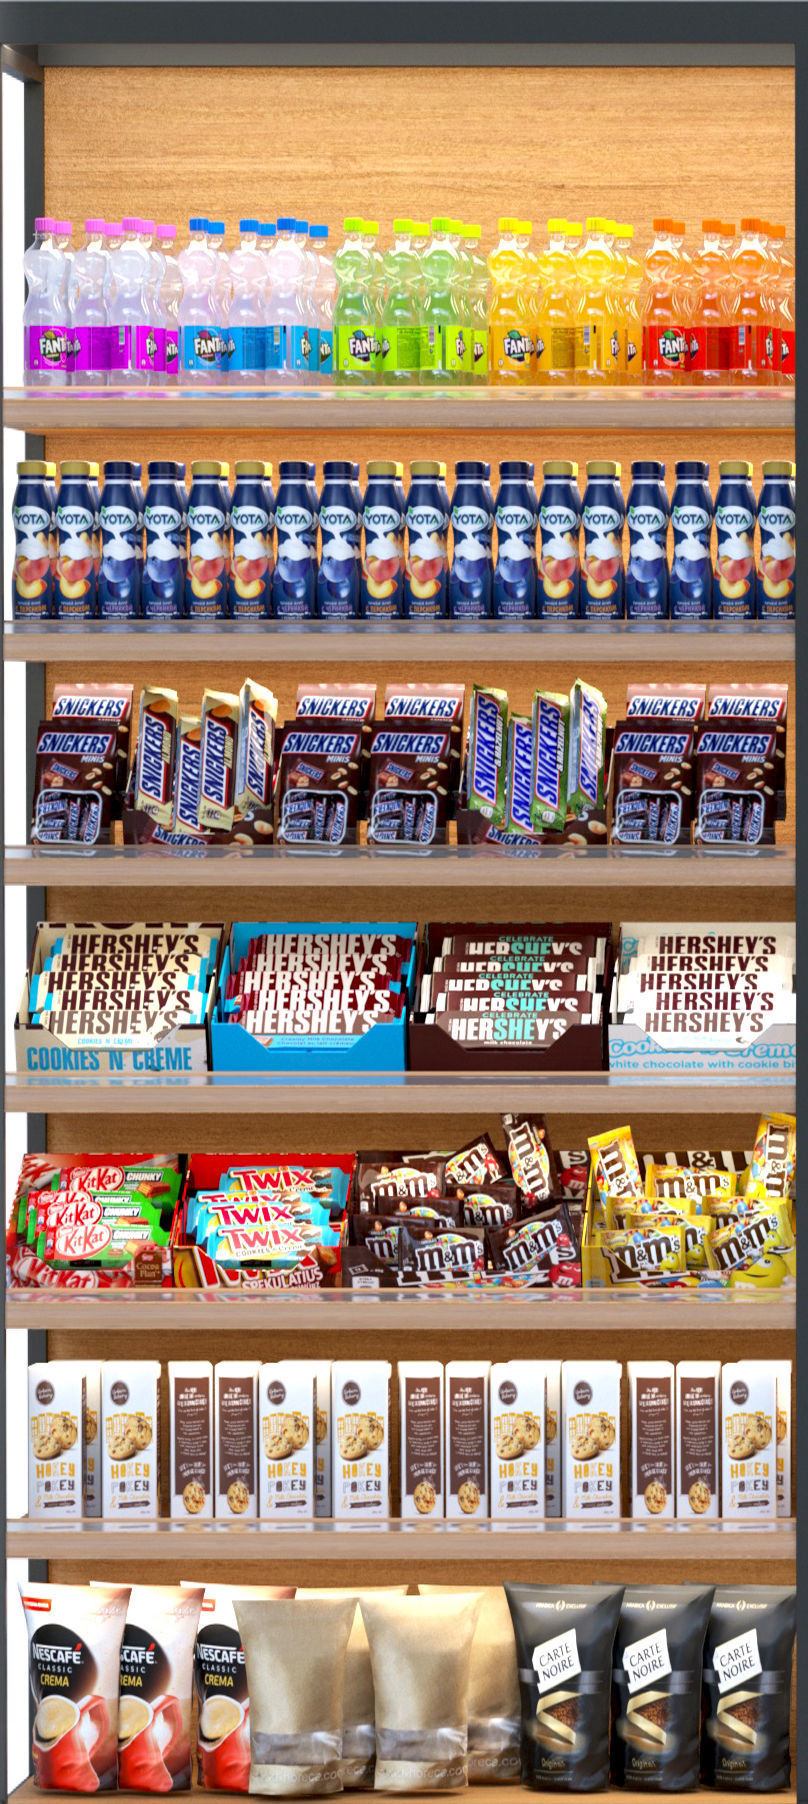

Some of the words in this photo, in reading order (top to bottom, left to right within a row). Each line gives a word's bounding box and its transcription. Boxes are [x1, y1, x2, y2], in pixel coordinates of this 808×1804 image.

[40, 336, 68, 355] FANT
[194, 336, 221, 355] FANT
[349, 336, 375, 355] FANT
[504, 336, 530, 355] FANT
[659, 336, 685, 355] FANT
[15, 514, 45, 525] YOTA
[58, 514, 88, 525] YOTA
[102, 514, 132, 525] YOTA
[146, 514, 176, 525] YOTA
[190, 514, 220, 525] YOTA
[234, 514, 263, 525] YOTA
[278, 514, 307, 525] YOTA
[321, 514, 351, 525] YOTA
[365, 514, 395, 525] YOTA
[409, 514, 439, 525] YOTA
[454, 514, 483, 525] YOTA
[498, 514, 528, 525] YOTA
[542, 514, 572, 525] YOTA
[586, 514, 615, 525] YOTA
[630, 514, 660, 525] YOTA
[674, 514, 704, 525] YOTA
[718, 514, 748, 525] YOTA
[761, 514, 791, 525] YOTA
[54, 698, 124, 717] SNICKERS
[299, 698, 368, 717] SNICKERS
[387, 698, 456, 717] SNICKERS
[630, 698, 699, 717] SNICKERS
[711, 698, 780, 717] SNICKERS
[39, 734, 110, 754] SNICKERS
[284, 734, 355, 754] SNICKERS
[373, 734, 444, 754] SNICKERS
[473, 695, 501, 801] SNICKERS
[537, 699, 562, 806] SNICKERS
[617, 734, 688, 754] SNICKERS
[699, 734, 770, 754] SNICKERS
[81, 755, 106, 763] MINIS
[142, 715, 165, 799] SNICKERS
[204, 720, 228, 802] SNICKERS
[327, 755, 352, 763] MINIS
[416, 755, 441, 763] MINIS
[659, 755, 684, 763] MINIS
[741, 755, 766, 763] MINIS
[71, 935, 199, 954] HERSHEY'S
[266, 935, 397, 955] HERSHEY'S
[659, 936, 776, 954] HERSHEY'S
[256, 954, 388, 974] HERSHEY'S
[244, 971, 376, 993] HERSHEY'S
[640, 973, 758, 992] HERSHEY'S
[62, 990, 190, 1011] HERSHEY'S
[258, 990, 391, 1012] HERSHEY'S
[656, 992, 774, 1011] HERSHEY'S
[51, 1011, 178, 1035] HERSHEY'S
[451, 1018, 567, 1041] HERSHEY'S
[645, 1012, 763, 1032] HERSHEY'S
[27, 1047, 100, 1071] COOKIES
[133, 1047, 192, 1071] CREME
[643, 1060, 704, 1069] chocolate
[708, 1060, 735, 1069] with
[738, 1060, 779, 1069] cookie
[127, 1173, 162, 1181] CHUNKY
[243, 1268, 323, 1288] SPEKULATIUS
[36, 1463, 75, 1478] HOKEY
[111, 1463, 150, 1478] HOKEY
[268, 1463, 307, 1478] HOKEY
[343, 1463, 382, 1478] HOKEY
[500, 1463, 538, 1478] HOKEY
[574, 1463, 613, 1478] HOKEY
[731, 1463, 770, 1478] HOKEY
[33, 1643, 82, 1665] NESCAFÉ
[539, 1641, 572, 1667] CARTE
[629, 1641, 662, 1667] CARTE
[720, 1641, 752, 1667] CARTE
[38, 1664, 73, 1675] CLASSIC
[202, 1664, 237, 1675] CLASSIC
[542, 1656, 575, 1681] NOIRE
[632, 1656, 665, 1681] NOIRE
[722, 1656, 756, 1681] NOIRE
[40, 1674, 70, 1688] CREMA
[120, 1675, 143, 1688] REMA
[204, 1674, 234, 1688] CREMA
